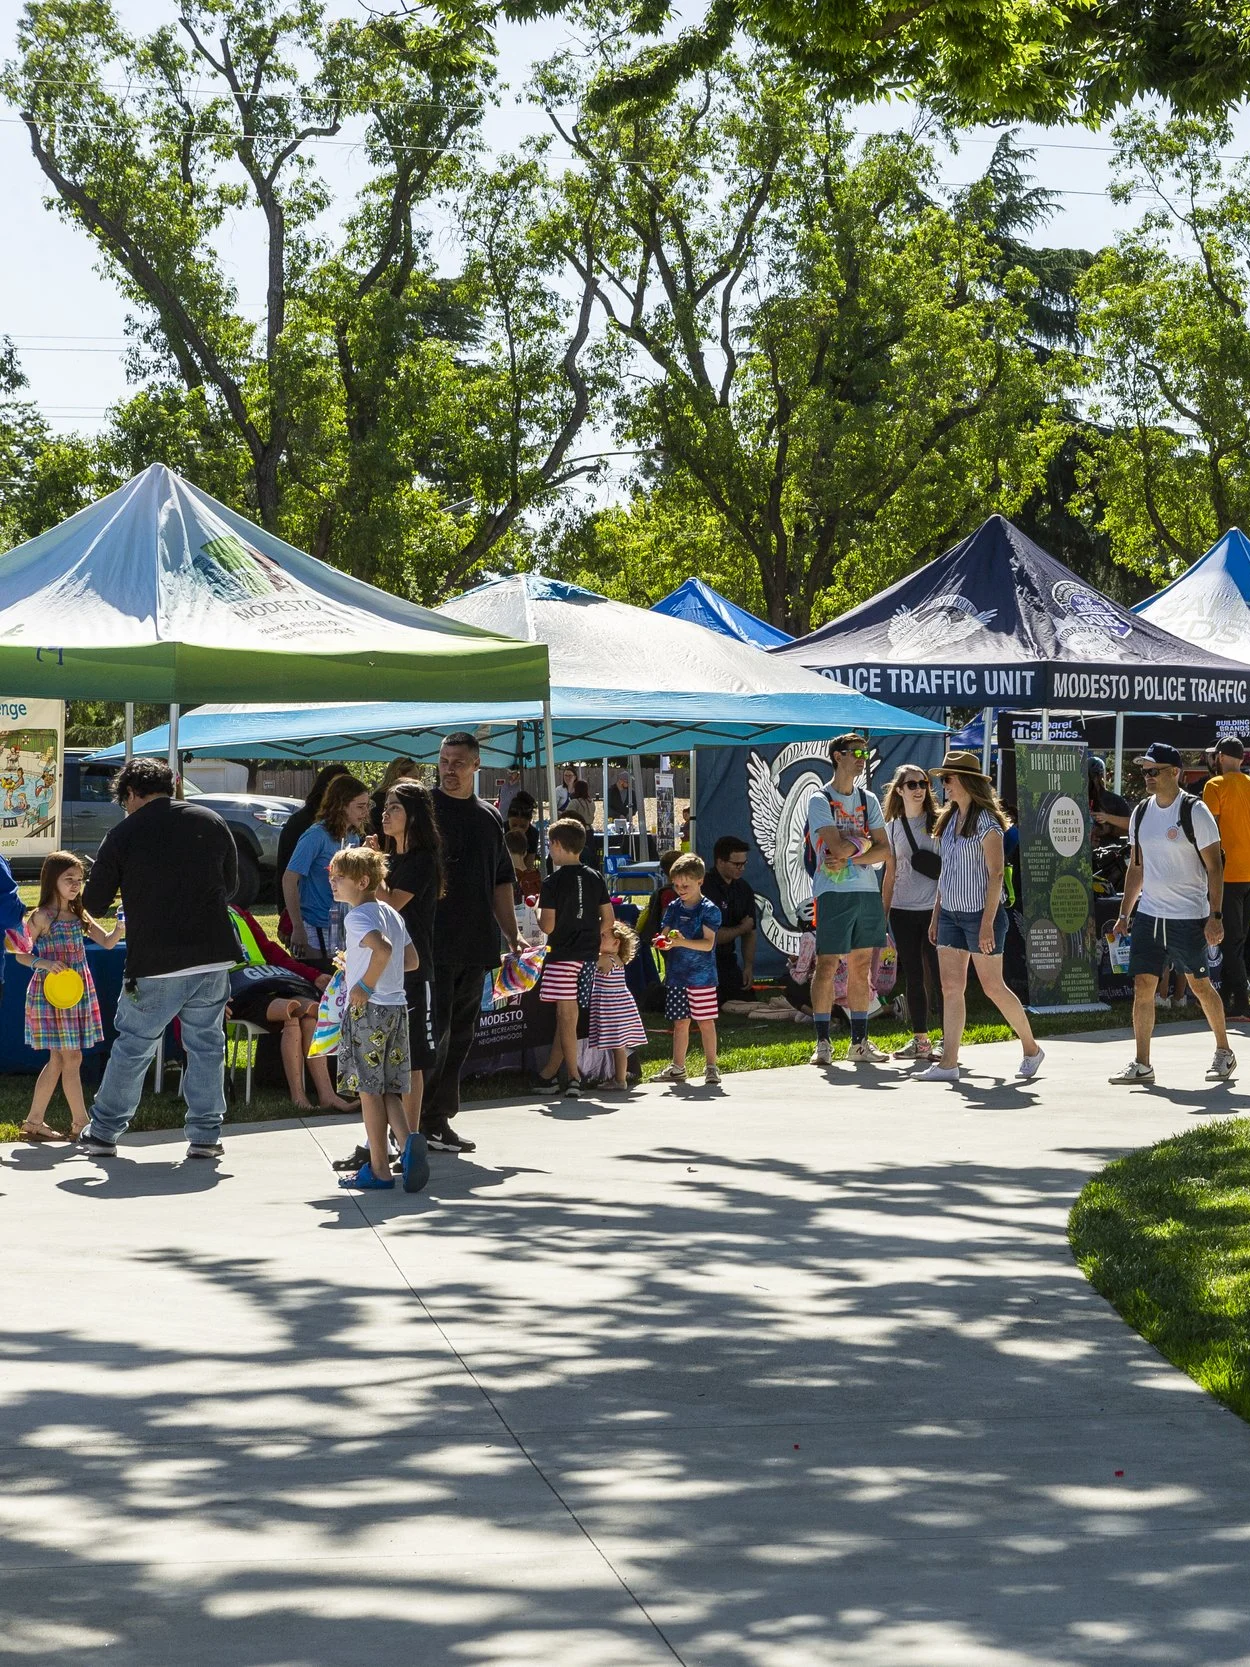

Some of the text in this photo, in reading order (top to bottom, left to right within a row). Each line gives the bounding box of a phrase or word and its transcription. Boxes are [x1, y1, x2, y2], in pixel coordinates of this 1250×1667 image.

[233, 600, 322, 621] MODESTO
[817, 668, 1035, 695] OLICE TRAFFIC UNIT
[1054, 673, 1130, 700] MODESTO
[1134, 676, 1186, 701] POLICE
[1190, 678, 1246, 704] TRAFFIC
[1031, 720, 1072, 731] aparel
[1031, 729, 1078, 740] grphics
[1031, 753, 1076, 772] BICYCLE SAFETY
[1048, 774, 1060, 790] TIPS
[1, 839, 19, 847] safe?
[766, 918, 800, 956] TRAFF
[480, 1010, 523, 1027] MODESTO
[491, 1024, 522, 1034] RECREATION
[478, 1032, 523, 1046] NEIGHBORHOODS
